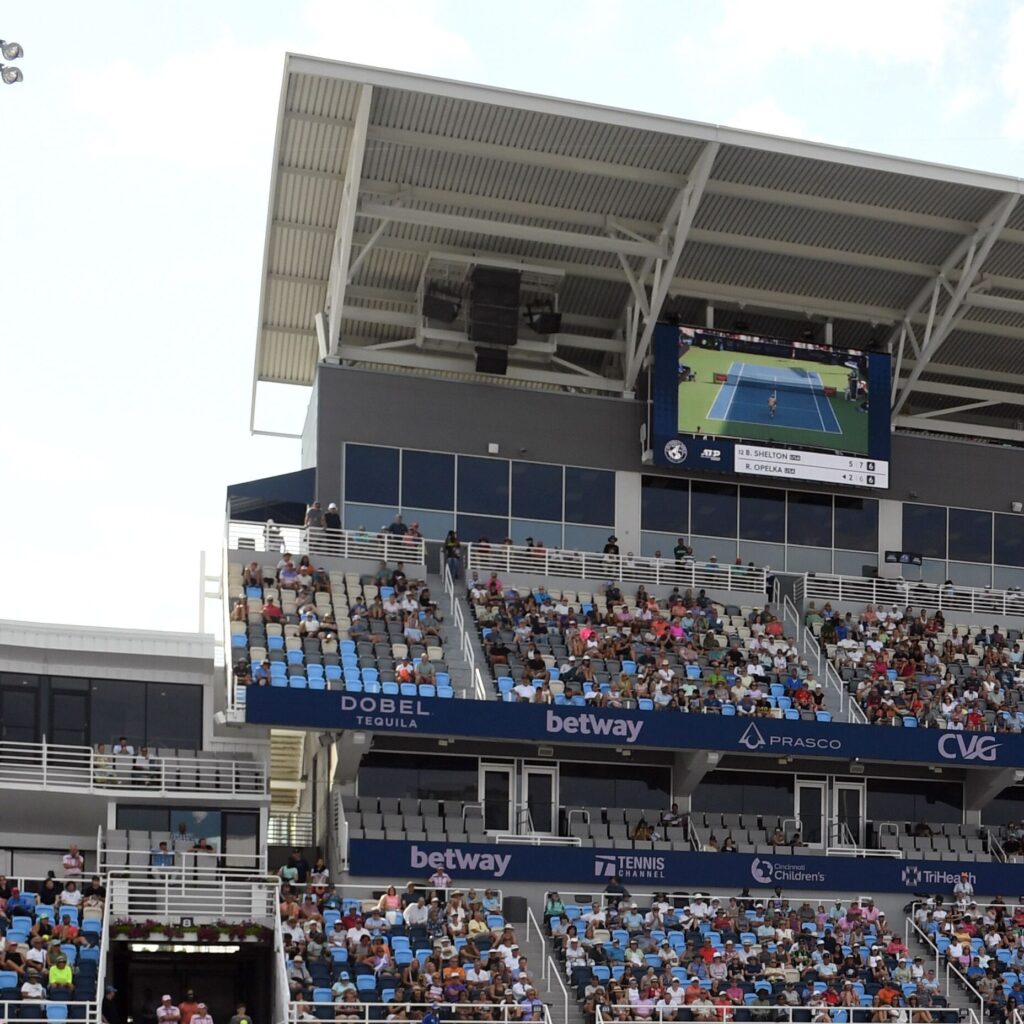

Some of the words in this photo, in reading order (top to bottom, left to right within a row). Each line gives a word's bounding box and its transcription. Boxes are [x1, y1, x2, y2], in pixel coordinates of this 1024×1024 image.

[754, 450, 788, 460] SHELTON
[753, 464, 782, 473] OPELKA
[340, 695, 430, 716] DOBEL
[356, 715, 418, 729] TEQUILA
[546, 709, 644, 742] betway
[769, 735, 842, 750] PRASCO
[937, 733, 1003, 761] CVG
[410, 845, 512, 877] betway
[618, 856, 665, 870] TENNIS
[774, 863, 806, 871] Cincinnati
[618, 869, 665, 879] CHANNEL
[774, 870, 825, 882] Children's
[922, 870, 977, 885] TriHeath
